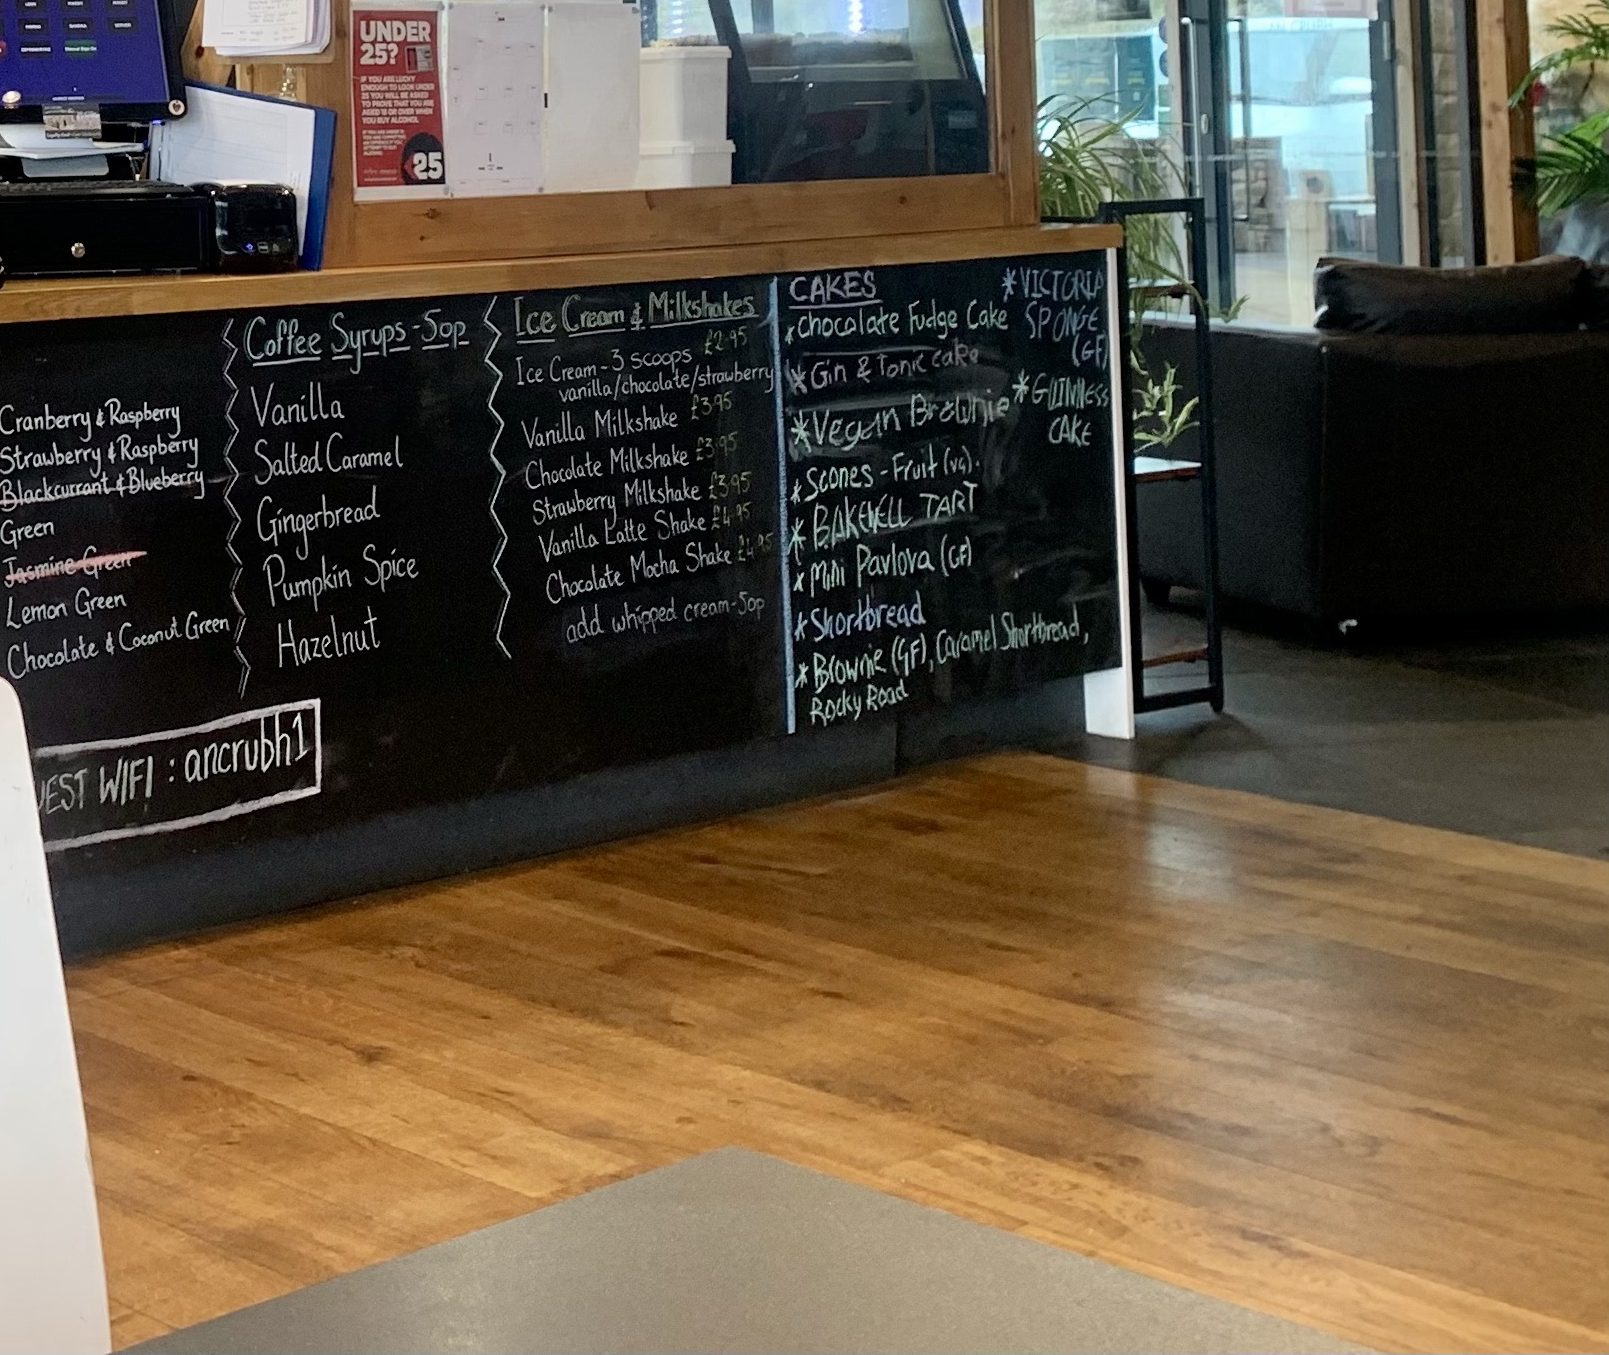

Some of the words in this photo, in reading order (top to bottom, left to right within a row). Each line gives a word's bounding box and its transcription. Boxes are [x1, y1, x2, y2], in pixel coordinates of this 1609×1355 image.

[360, 20, 431, 42] UNDER
[360, 43, 399, 65] 25?
[413, 151, 443, 180] 25
[790, 270, 877, 301] CAKES
[1020, 268, 1105, 301] VICTORIA
[515, 296, 556, 336] Ice
[561, 294, 624, 334] Cream
[649, 291, 754, 324] Milkshakes
[909, 299, 958, 339] Fudge
[966, 300, 1008, 330] Cake
[1026, 301, 1098, 342] SPONGE
[245, 315, 322, 360] Coffee
[330, 312, 405, 374] Syrups
[1072, 332, 1108, 370] (GF)
[516, 356, 543, 385] Ice
[630, 348, 692, 373] scoops
[811, 359, 847, 389] Gin
[250, 382, 344, 427] Vanilla
[1032, 373, 1108, 410] GUINNESS
[105, 398, 181, 437] Raspberry
[522, 410, 585, 448] Vanilla
[595, 403, 678, 439] Milkshake
[813, 409, 900, 451] Vegan
[910, 393, 1009, 427] Brownie
[1049, 414, 1092, 447] CAKE
[0, 443, 102, 477] Strawberry
[120, 434, 199, 468] Raspberry
[254, 440, 323, 485] Salted
[326, 432, 403, 473] Caramel
[525, 451, 602, 490] Chocolate
[610, 442, 689, 475] Milkshake
[806, 465, 873, 497] Scones
[892, 444, 938, 481] Fruit
[126, 467, 204, 499] Blueberry
[533, 489, 615, 528] Strawberry
[624, 478, 700, 508] Milkshake
[0, 520, 54, 549] Green
[256, 485, 381, 560] Gingerbread
[539, 524, 599, 562] Vanilla
[605, 516, 648, 545] Latte
[654, 508, 706, 540] Shake
[814, 494, 912, 551] BAKEWELL
[919, 481, 977, 519] TART
[3, 555, 77, 586] Jasmine
[82, 546, 132, 580] Green
[262, 553, 352, 612] Pumpkin
[363, 544, 419, 593] Spice
[546, 568, 624, 604] Chocolate
[630, 553, 679, 583] Mocha
[686, 542, 731, 572] Shake
[857, 543, 935, 587] Pavlova
[5, 596, 67, 629] Lemon
[74, 586, 126, 619] Green
[566, 604, 604, 643] add
[612, 597, 677, 634] whipped
[811, 591, 926, 642] Shortbread
[7, 636, 98, 680] Chocolate
[118, 616, 183, 652] Coconut
[185, 610, 229, 640] Green
[278, 606, 381, 668] Hazelnut
[813, 643, 887, 694] Brownie
[936, 614, 996, 664] Caramel
[811, 690, 862, 727] Rocky
[867, 679, 909, 710] Road
[100, 756, 154, 806] WIFI
[185, 710, 309, 782] ancrubh1
